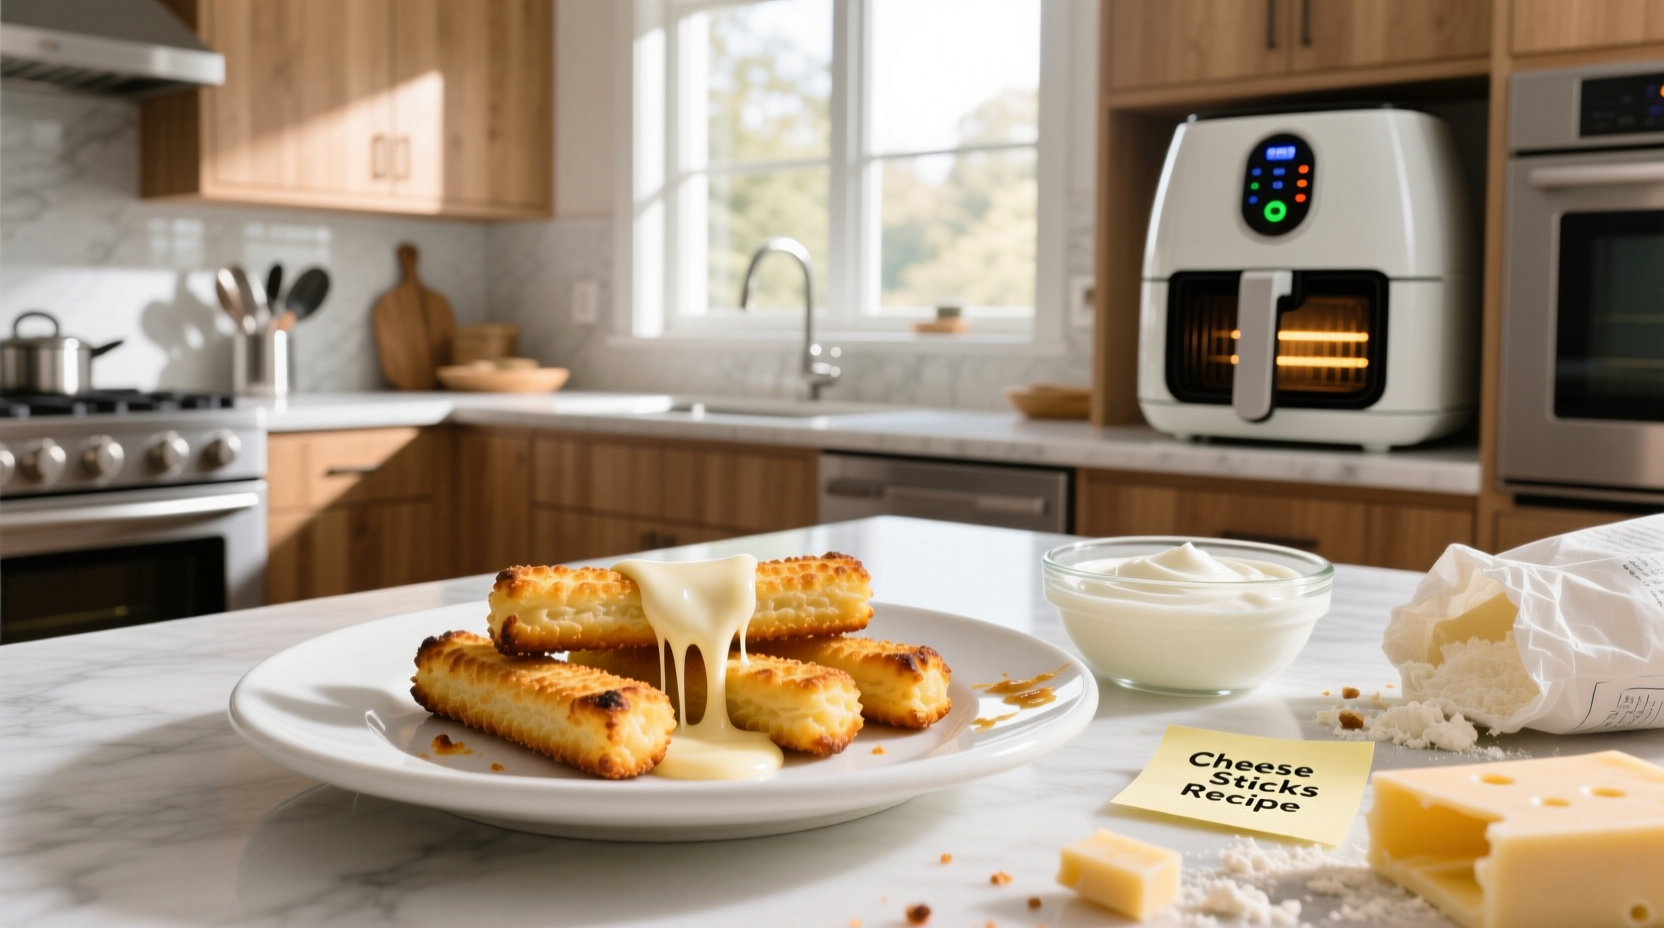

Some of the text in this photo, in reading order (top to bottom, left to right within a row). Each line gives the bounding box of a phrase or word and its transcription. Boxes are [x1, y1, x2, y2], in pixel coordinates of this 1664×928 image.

[1189, 752, 1314, 777] Cheese
[1209, 772, 1319, 797] Sticks
[1180, 783, 1300, 812] Recipe
